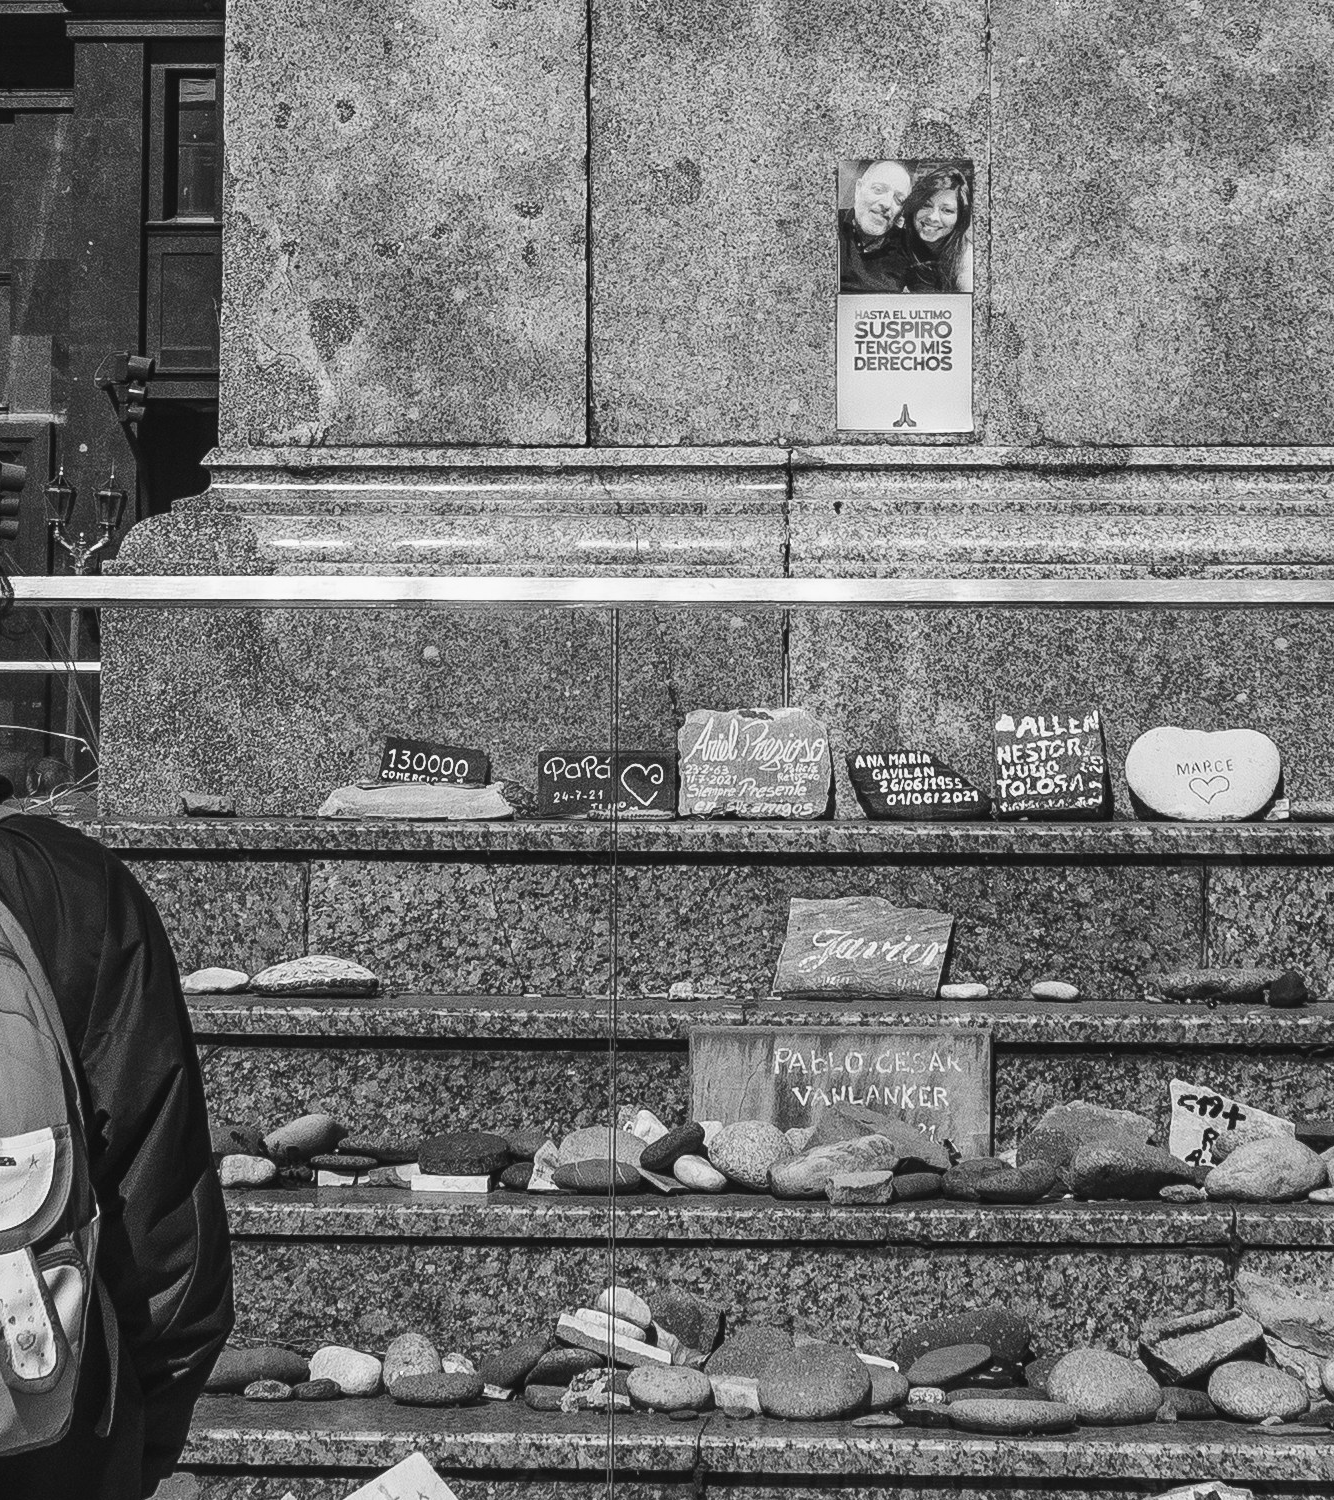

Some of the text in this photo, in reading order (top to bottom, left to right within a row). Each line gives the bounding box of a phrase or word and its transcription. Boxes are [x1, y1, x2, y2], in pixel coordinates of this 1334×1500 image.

[854, 310, 952, 320] HASTA EL ULTIMO
[854, 321, 953, 339] SUSPIRO
[854, 340, 953, 355] TENGO MIS
[854, 356, 953, 371] DERECHOS
[1016, 710, 1099, 738] ALLEN
[997, 738, 1082, 765] NESTOR
[387, 749, 469, 778] 130000
[855, 754, 885, 769] ANA
[1176, 758, 1234, 776] MARCE
[879, 776, 963, 793] 26/06/1955
[553, 789, 604, 803] 24-7-21
[886, 790, 979, 806] 01/06/2021
